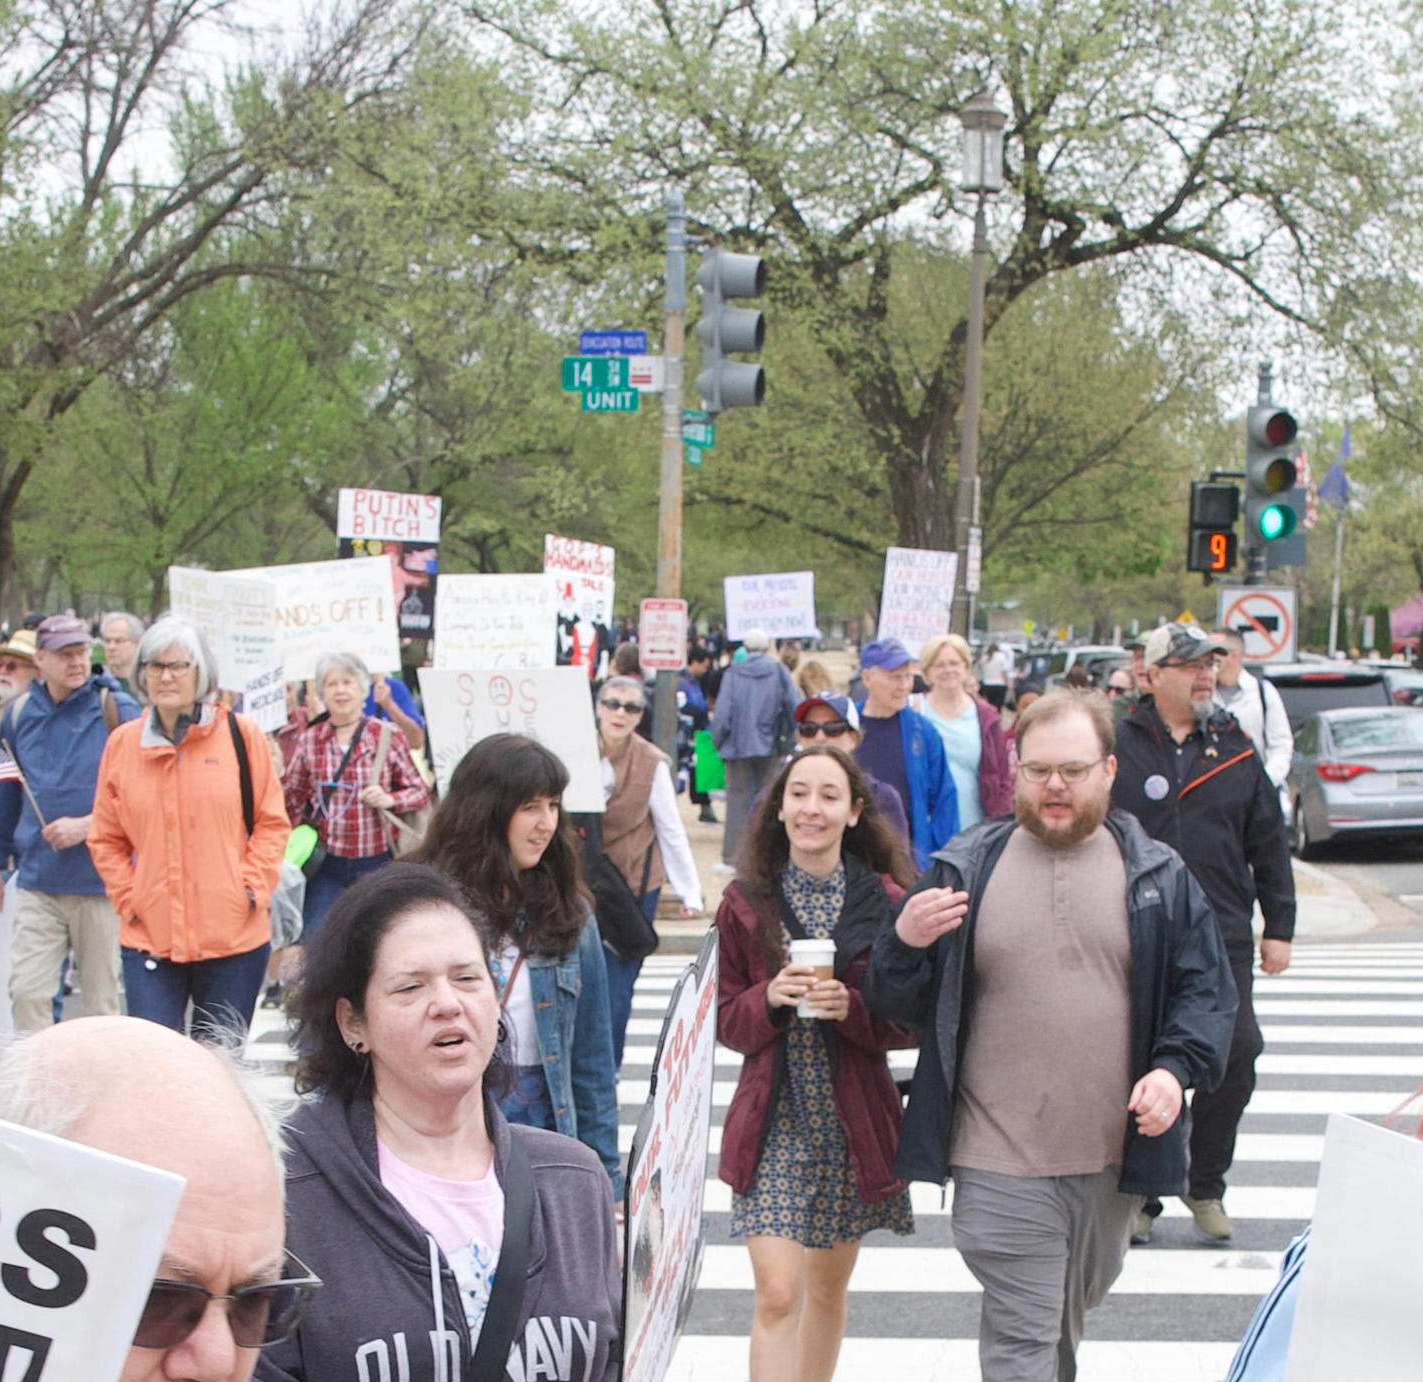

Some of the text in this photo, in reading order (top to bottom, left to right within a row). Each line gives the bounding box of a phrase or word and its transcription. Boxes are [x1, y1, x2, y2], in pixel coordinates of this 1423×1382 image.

[574, 362, 592, 387] 14
[587, 391, 633, 410] UNIT
[353, 514, 420, 537] BITCH
[1210, 533, 1226, 569] 9
[275, 603, 322, 627] ANDS
